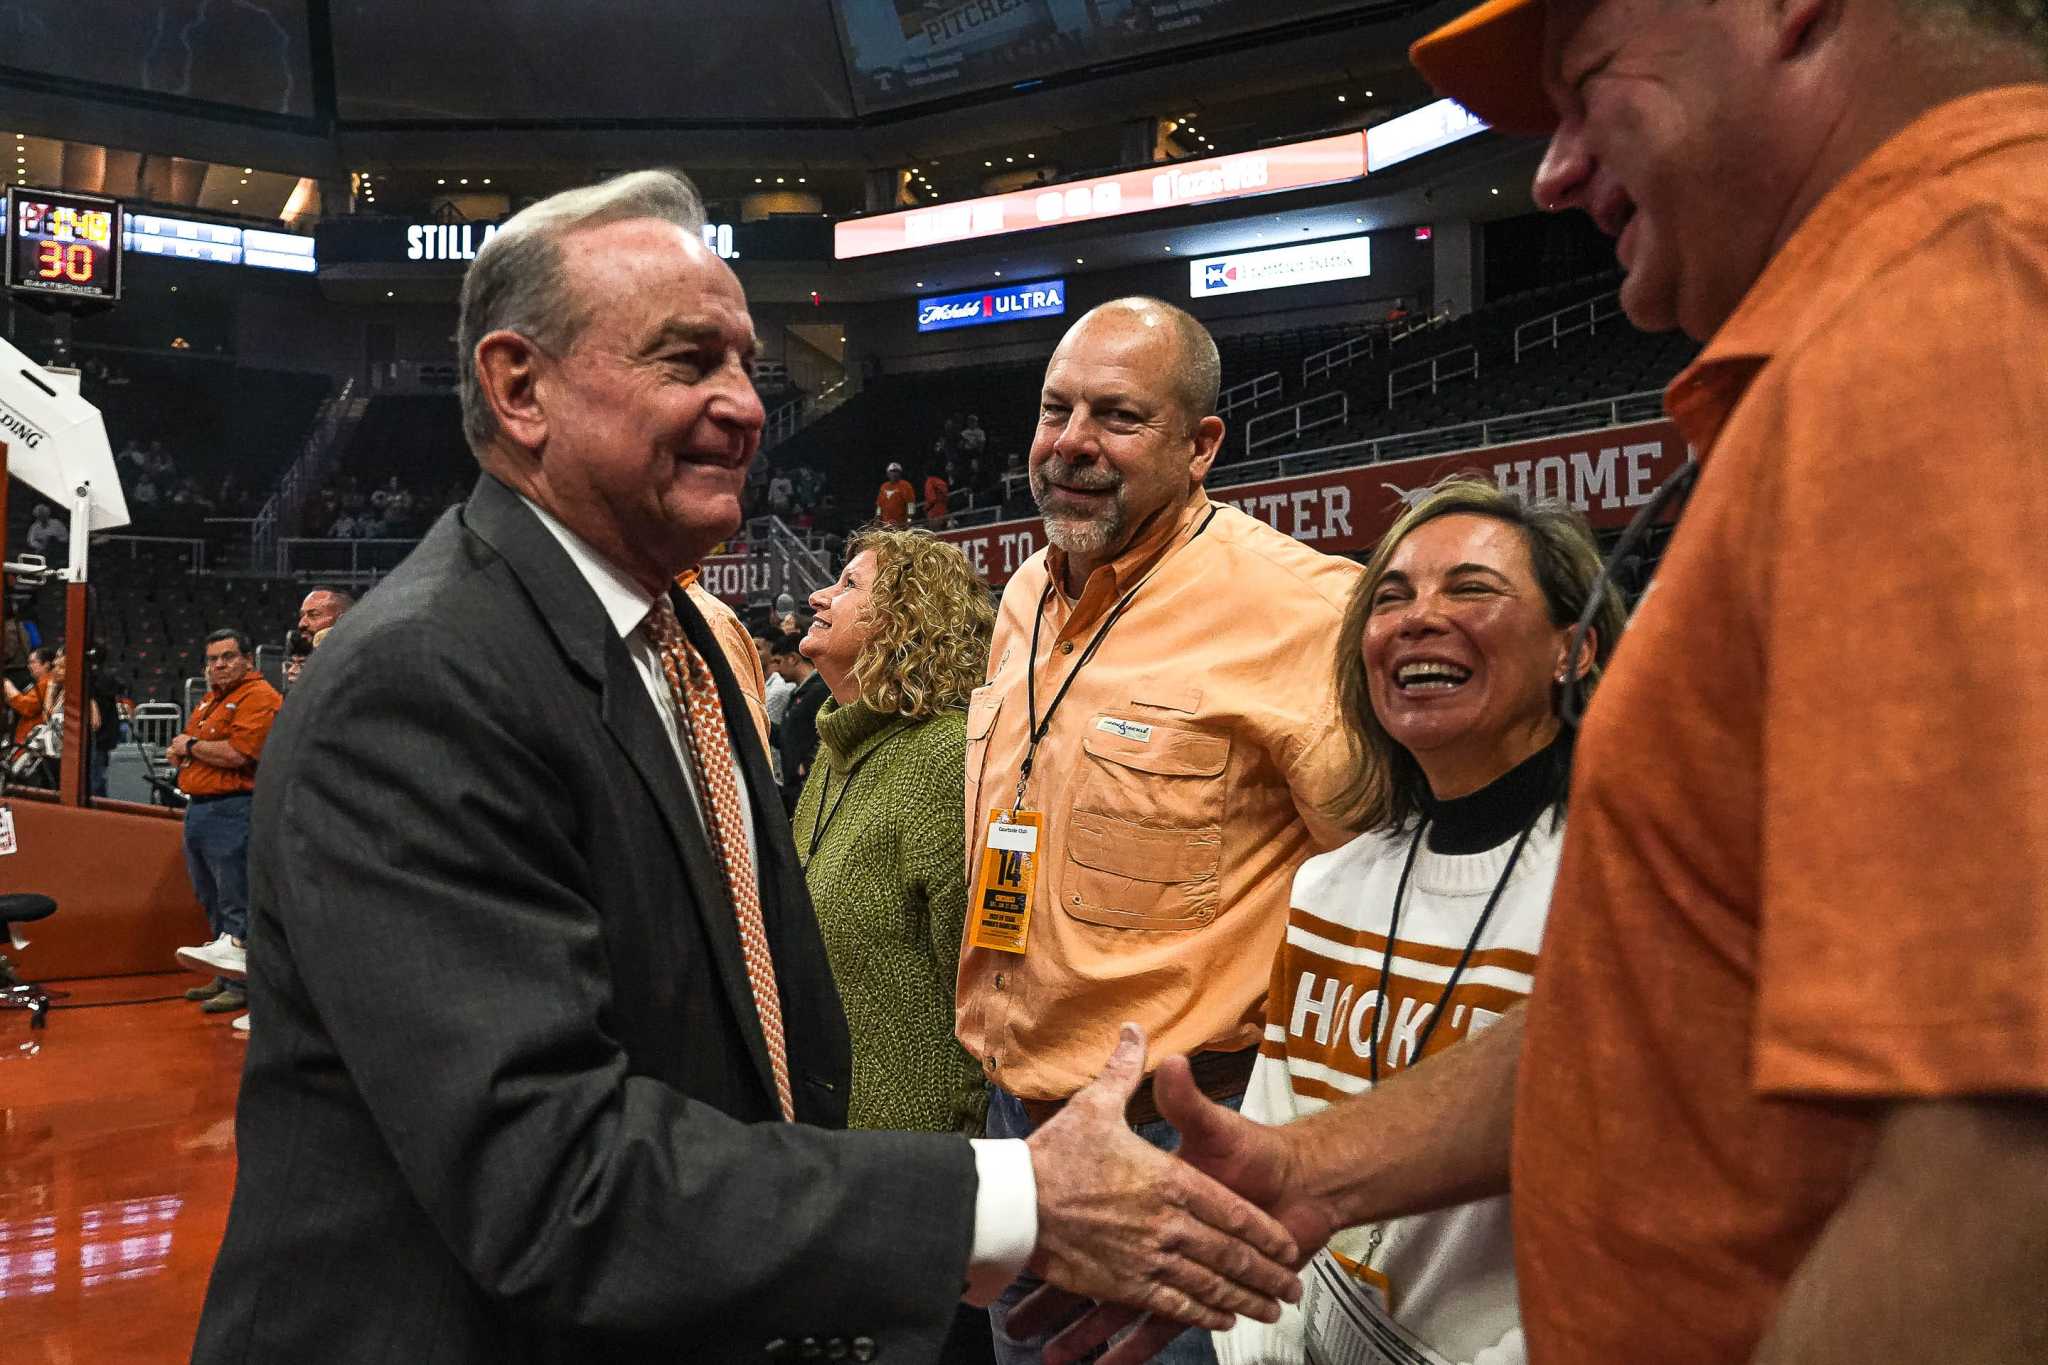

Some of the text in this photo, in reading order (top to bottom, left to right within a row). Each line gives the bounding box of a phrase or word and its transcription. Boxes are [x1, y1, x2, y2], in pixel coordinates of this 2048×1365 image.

[39, 240, 94, 282] 30
[407, 223, 476, 260] STILL
[995, 289, 1062, 313] ULTRA
[1494, 441, 1662, 512] HOME
[997, 848, 1023, 888] 14
